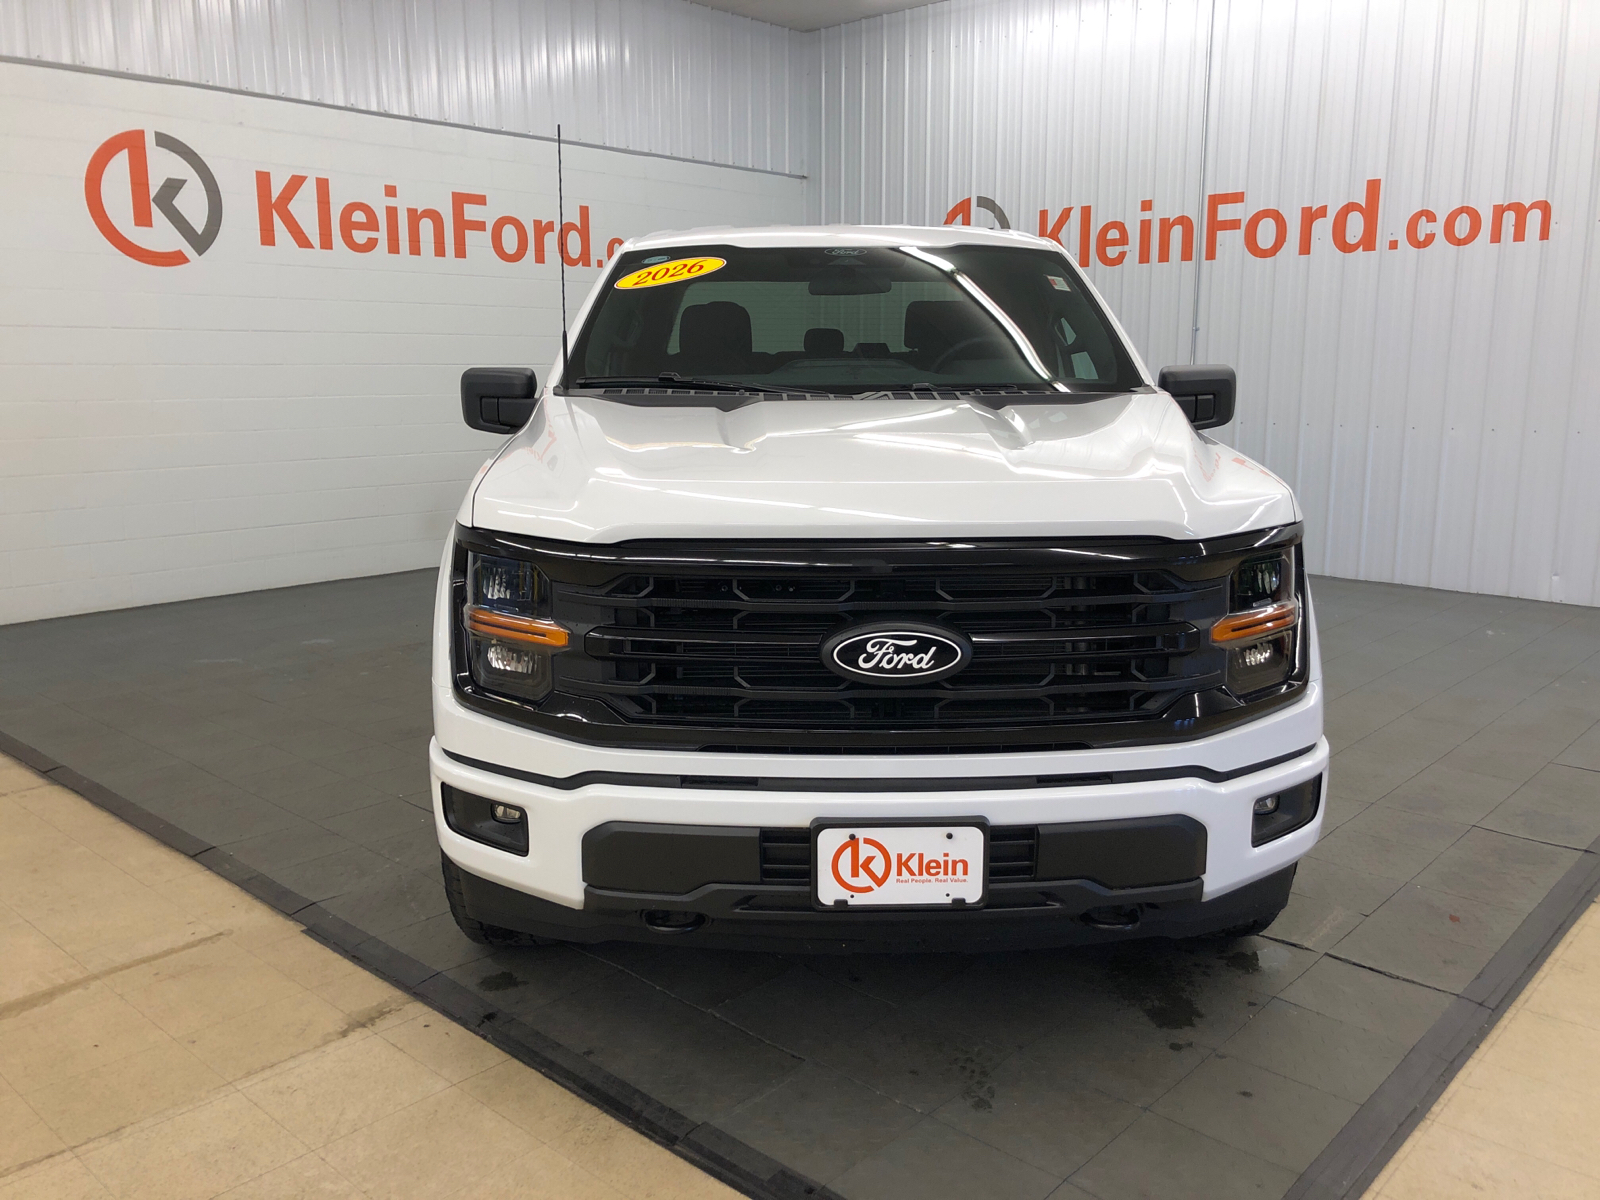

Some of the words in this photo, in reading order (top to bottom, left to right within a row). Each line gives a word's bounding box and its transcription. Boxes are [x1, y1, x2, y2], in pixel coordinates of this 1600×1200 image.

[1038, 179, 1552, 268] KleinFord.com
[632, 260, 708, 287] 2026
[858, 638, 937, 669] Ford
[896, 852, 969, 877] Klein
